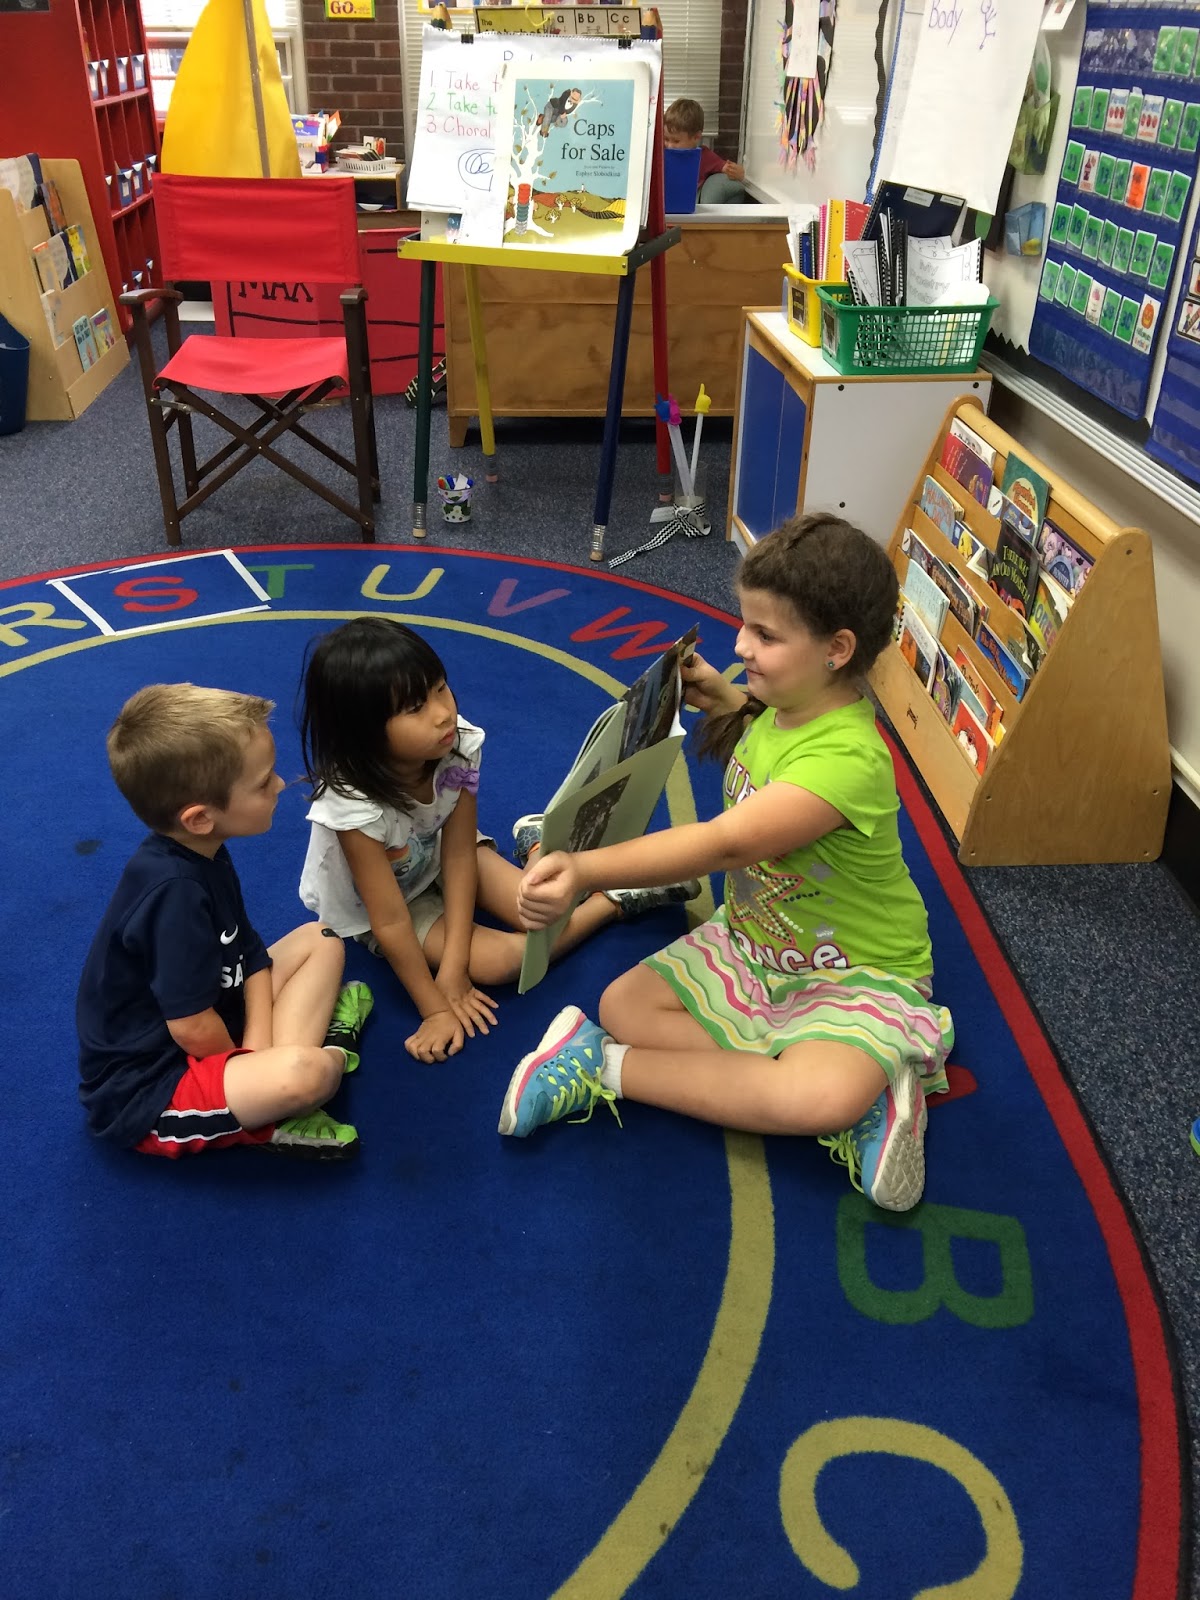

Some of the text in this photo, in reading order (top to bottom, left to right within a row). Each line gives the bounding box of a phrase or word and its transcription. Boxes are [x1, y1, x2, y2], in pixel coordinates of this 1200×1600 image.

[929, 0, 963, 45] Body
[446, 70, 480, 91] Take
[447, 92, 479, 115] Take
[443, 116, 491, 138] Choral
[573, 118, 615, 140] Caps
[561, 142, 625, 161] for Sale
[1056, 215, 1066, 231] 18
[1072, 215, 1082, 235] 19
[113, 576, 198, 613] S
[249, 564, 314, 599] T
[360, 564, 445, 602] U
[486, 578, 572, 617] V
[836, 1194, 1034, 1329] B
